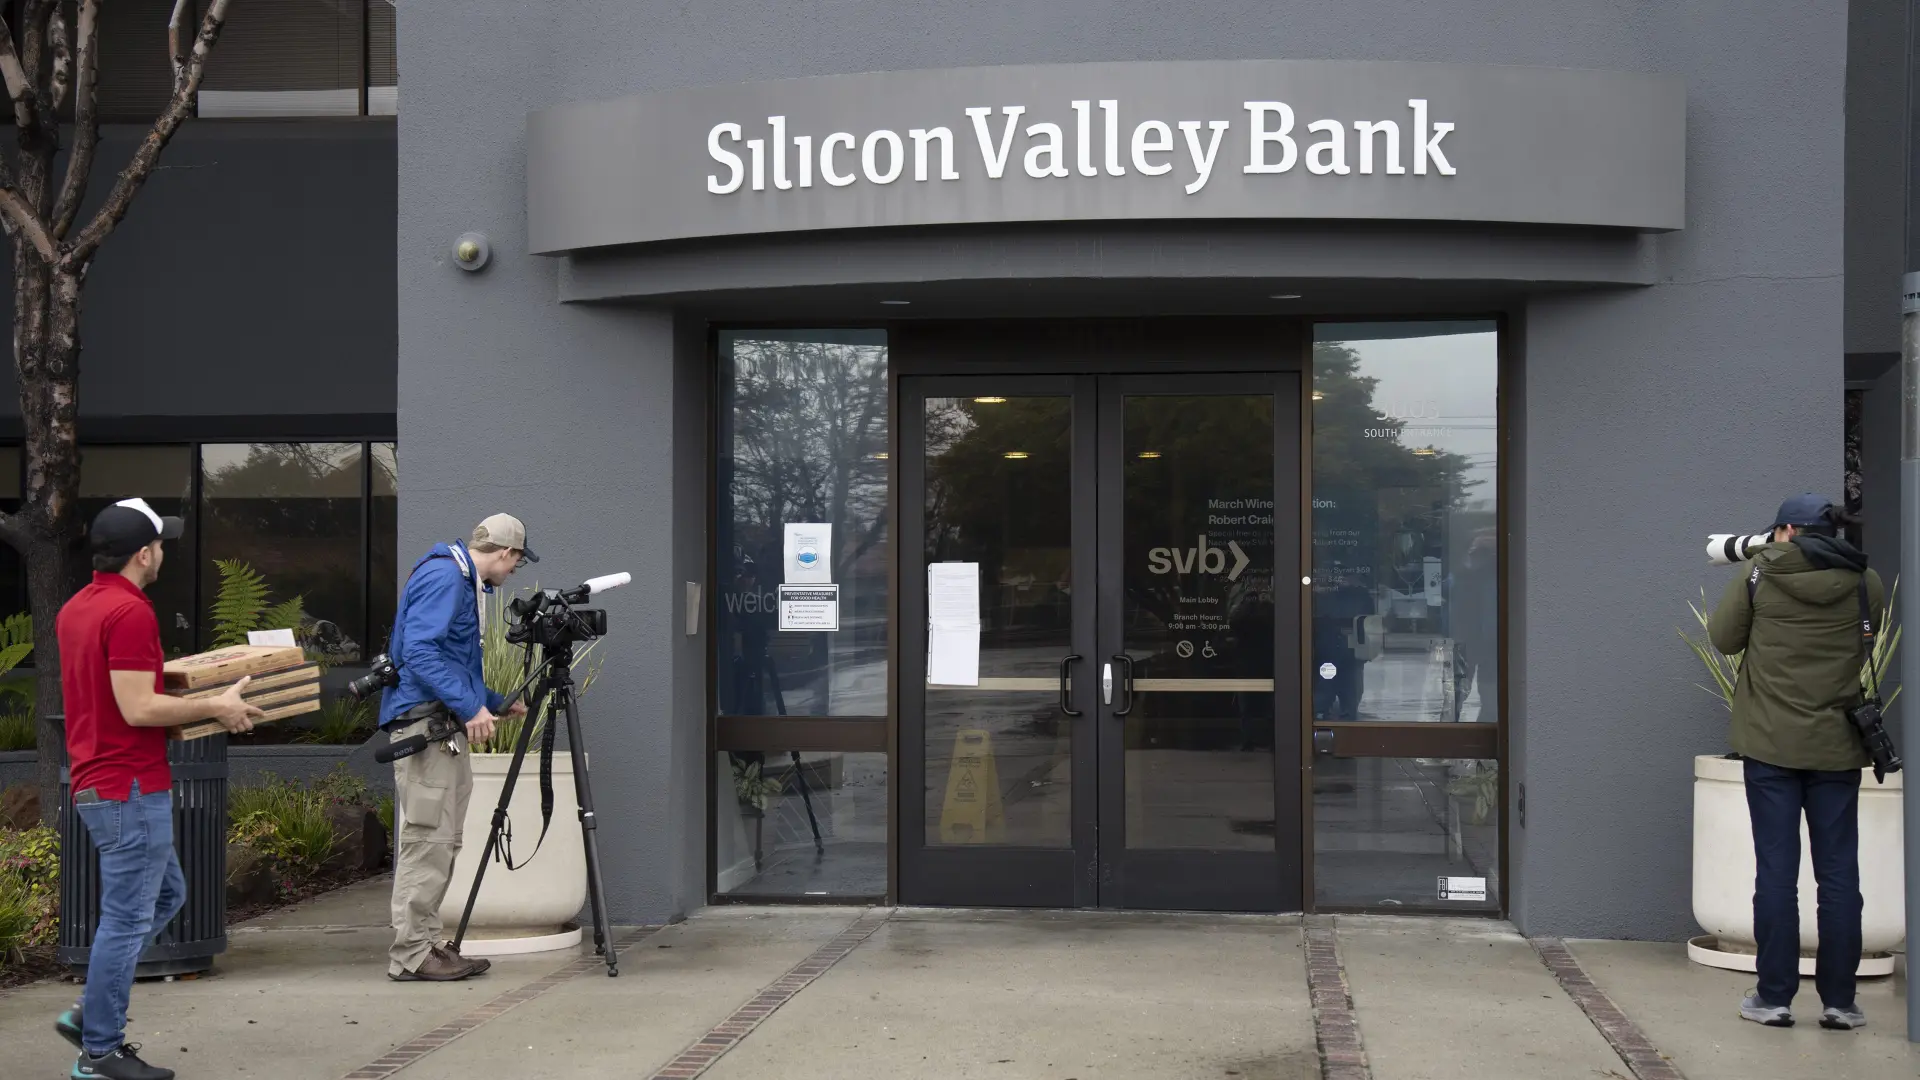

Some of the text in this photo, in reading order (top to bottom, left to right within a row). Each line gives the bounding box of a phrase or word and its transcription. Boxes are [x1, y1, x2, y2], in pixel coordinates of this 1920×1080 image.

[707, 99, 1457, 195] Silicon Valley Bank
[1364, 427, 1452, 438] SOUTH ENTRANCE
[1208, 498, 1336, 509] March Wine tion:
[1208, 514, 1247, 525] Robert
[1147, 534, 1226, 575] svb
[724, 584, 779, 614] welc
[1197, 596, 1219, 605] Lobby
[1173, 613, 1198, 621] Branch
[1168, 622, 1184, 630] 9:00
